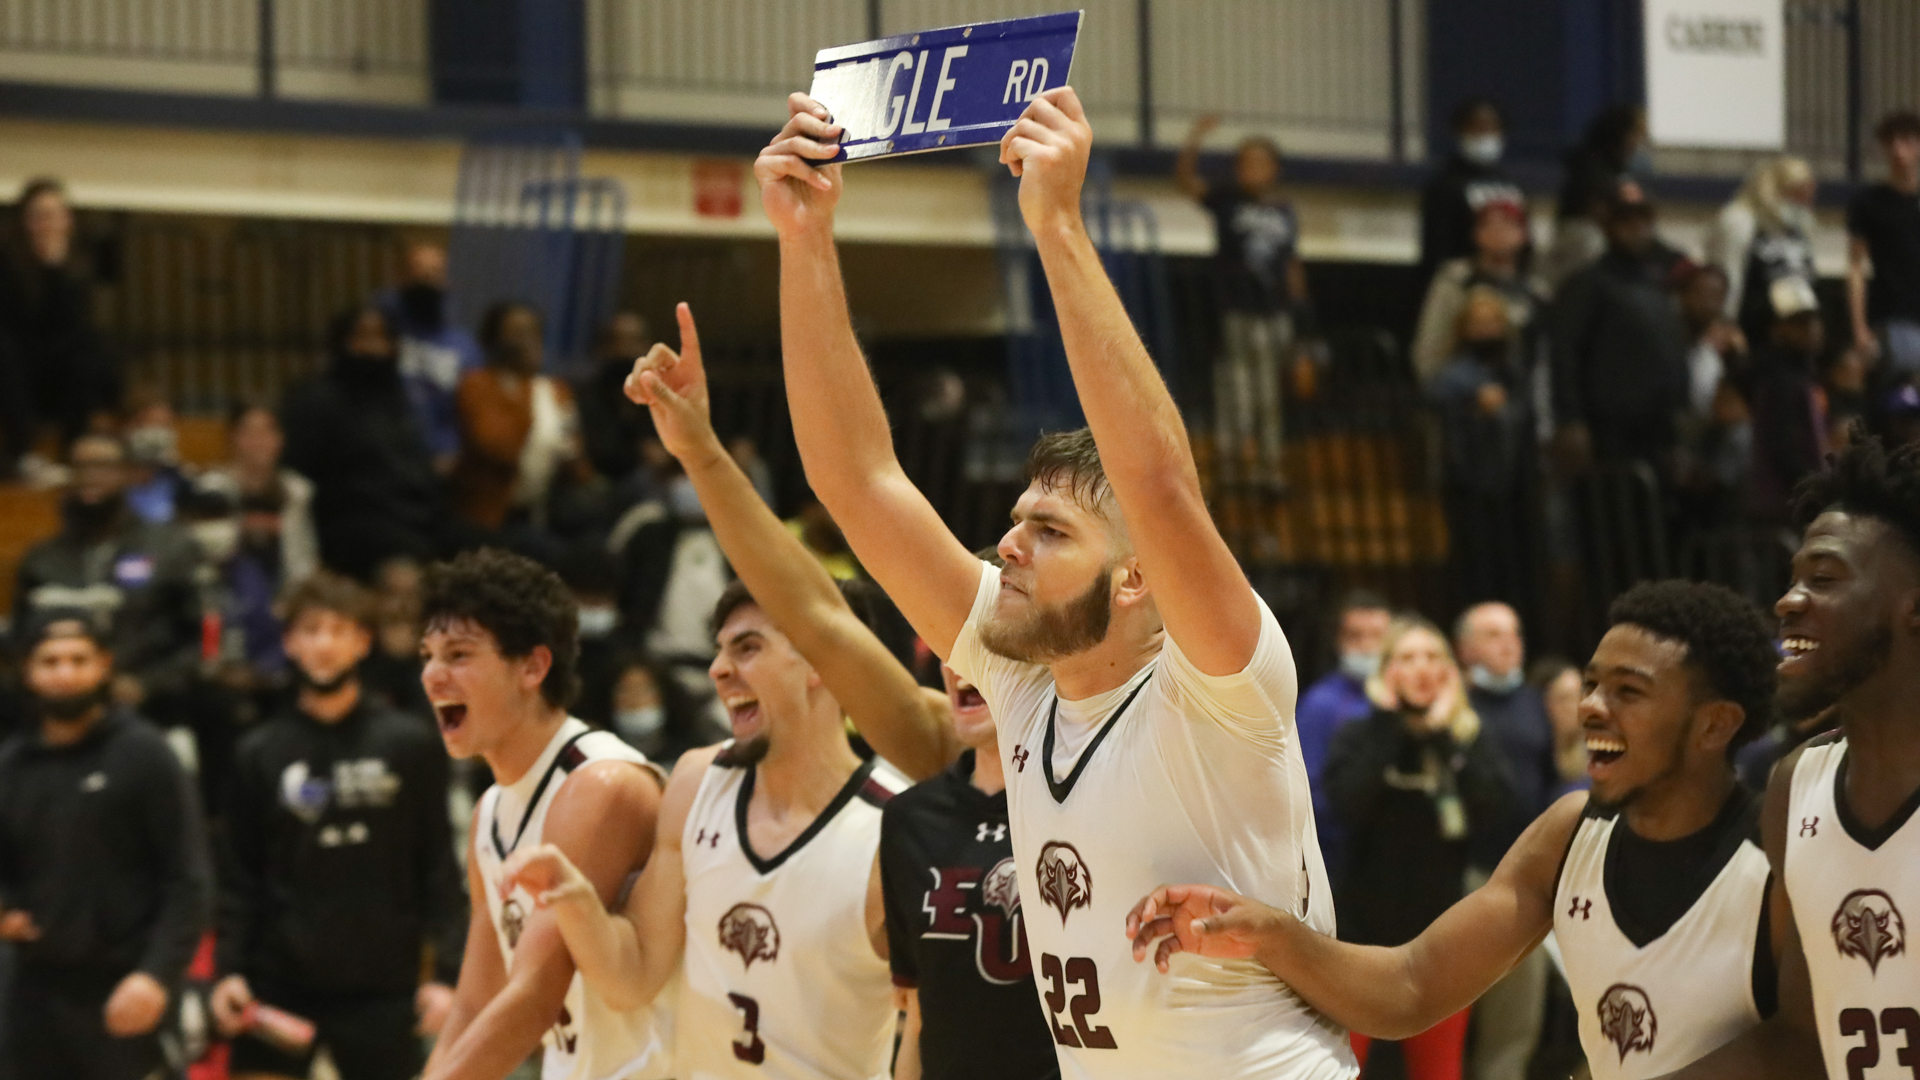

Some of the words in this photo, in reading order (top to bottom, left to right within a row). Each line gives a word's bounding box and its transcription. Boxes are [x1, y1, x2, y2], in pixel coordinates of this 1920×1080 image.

[835, 45, 968, 142] GLE
[1002, 57, 1049, 104] RD
[727, 992, 765, 1065] 3
[1041, 952, 1118, 1049] 22
[1838, 1006, 1920, 1080] 23
